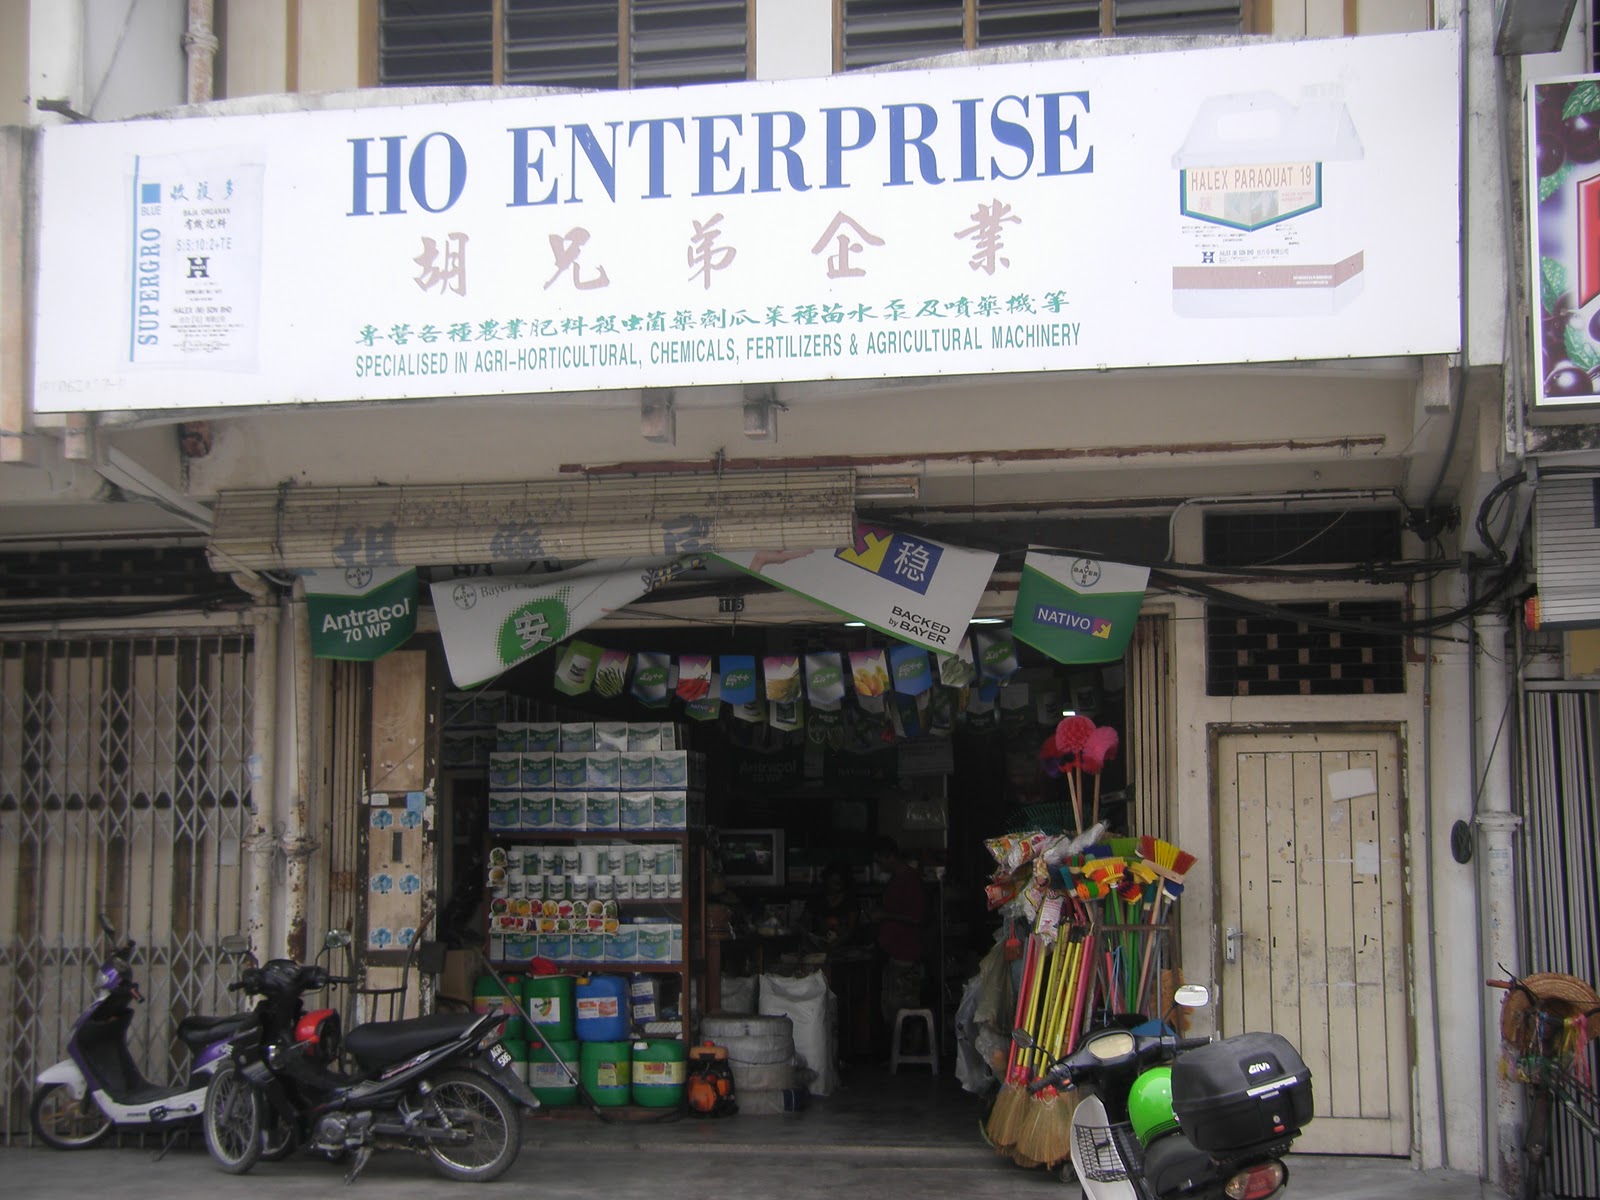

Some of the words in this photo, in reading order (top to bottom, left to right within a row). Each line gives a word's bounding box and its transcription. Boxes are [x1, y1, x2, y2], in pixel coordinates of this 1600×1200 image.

[346, 132, 467, 217] HO
[506, 90, 1094, 207] ENTERPRISE
[1191, 170, 1228, 191] HALEX
[1234, 167, 1293, 189] PARAQUAT
[1300, 165, 1312, 186] 19
[141, 206, 161, 216] BLUE
[137, 227, 161, 346] SUPERGRO
[356, 351, 448, 377] SPECIALISED
[455, 350, 468, 374] IN
[475, 343, 643, 372] AGRI-HORTICULTURAL,
[650, 339, 740, 365] CHEMICALS,
[747, 333, 842, 360] FERTILIZERS
[850, 335, 859, 355] &
[867, 327, 982, 355] AGRICULTURAL
[991, 322, 1081, 350] MACHINERY
[893, 541, 930, 582] 稳
[480, 583, 512, 599] Bayer
[321, 597, 411, 635] Antracol
[892, 606, 951, 635] BACKED
[1038, 608, 1091, 630] NATIVO
[344, 628, 362, 644] 70
[364, 622, 392, 639] WP
[514, 609, 554, 652] 安
[888, 617, 899, 628] by
[899, 620, 947, 645] BAYER
[1248, 1062, 1271, 1074] GIVI
